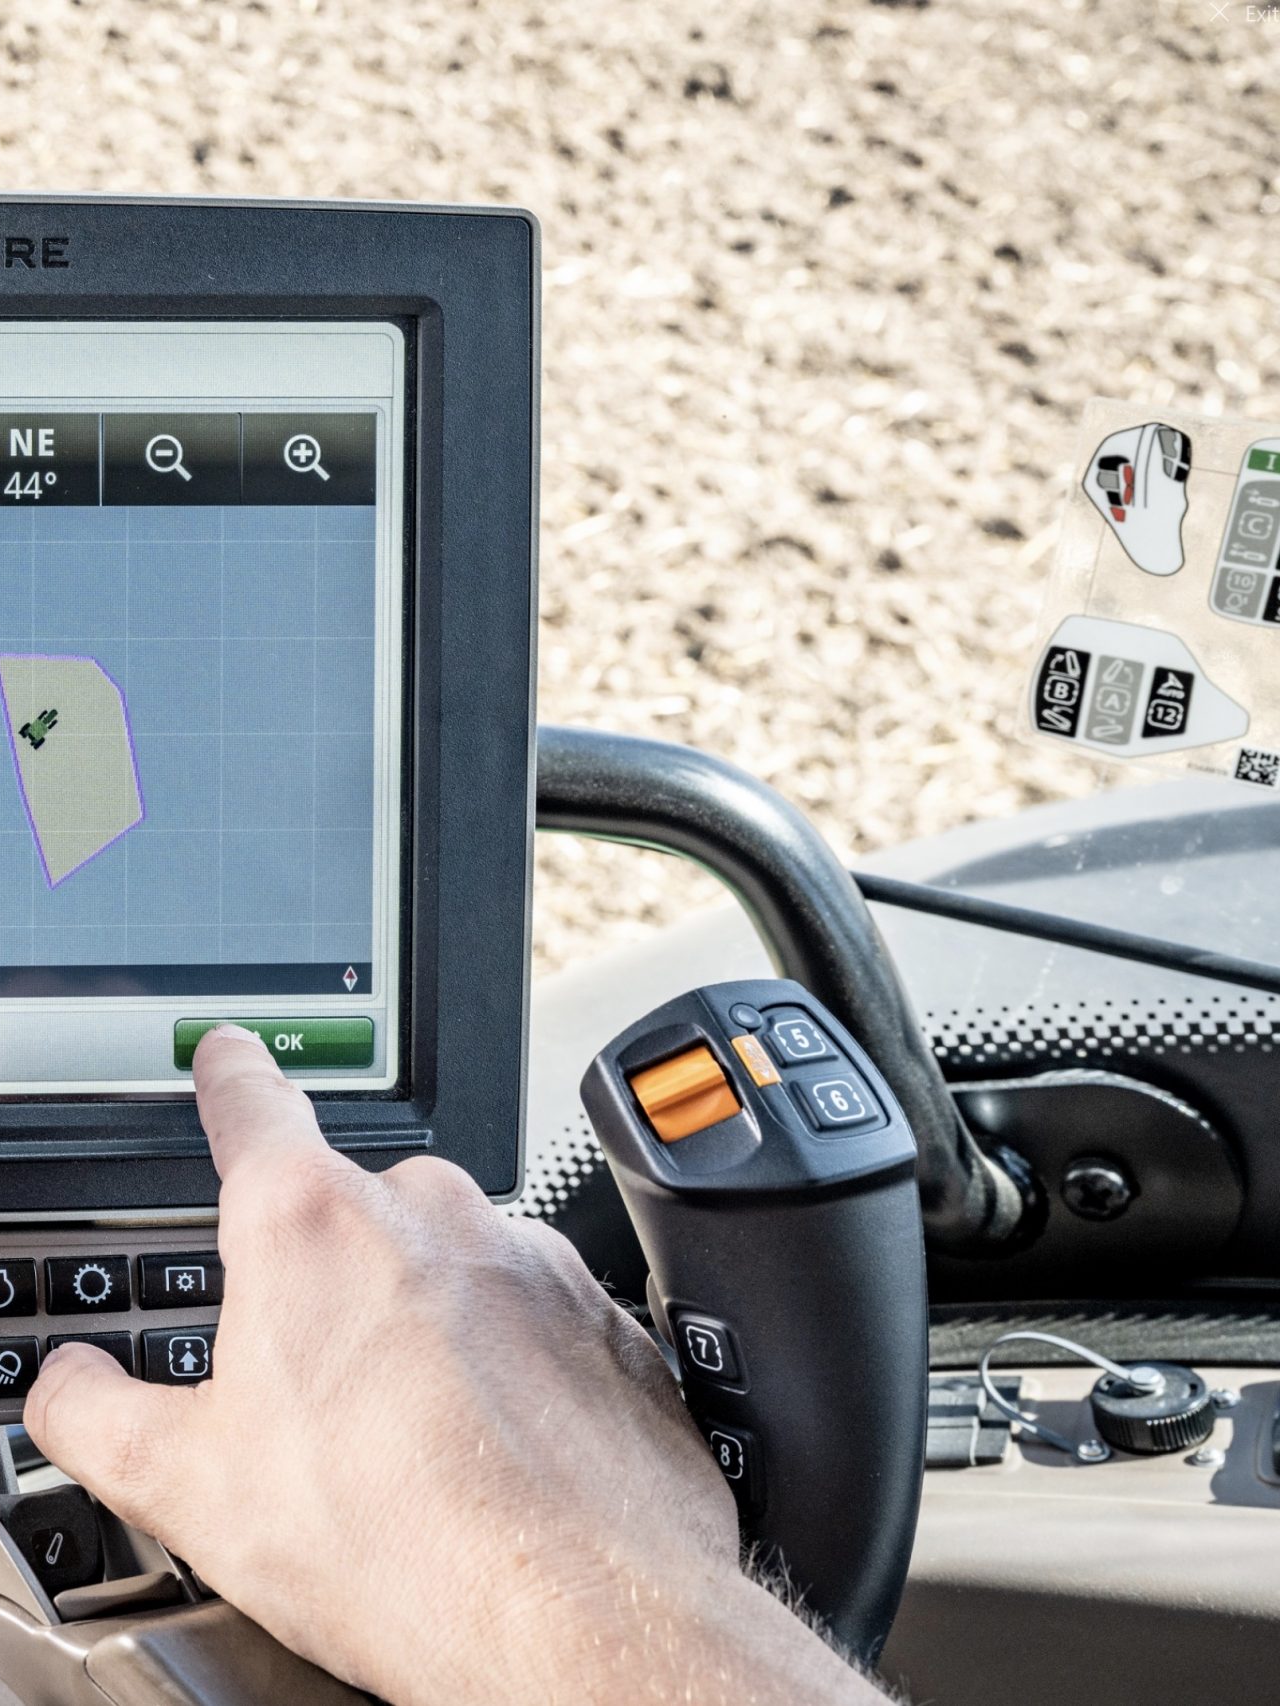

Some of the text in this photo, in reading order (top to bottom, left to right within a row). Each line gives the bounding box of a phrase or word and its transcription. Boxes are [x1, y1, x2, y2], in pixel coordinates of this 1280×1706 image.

[9, 428, 55, 457] NE
[3, 471, 57, 500] 44°
[1248, 518, 1263, 534] C
[1234, 573, 1251, 587] 10
[1053, 682, 1069, 699] B
[1103, 693, 1120, 710] A
[1156, 707, 1177, 723] 12
[274, 1033, 304, 1051] OK
[790, 1027, 809, 1048] 5
[829, 1089, 849, 1111] 6
[696, 1336, 707, 1359] 7
[720, 1443, 731, 1466] 8
